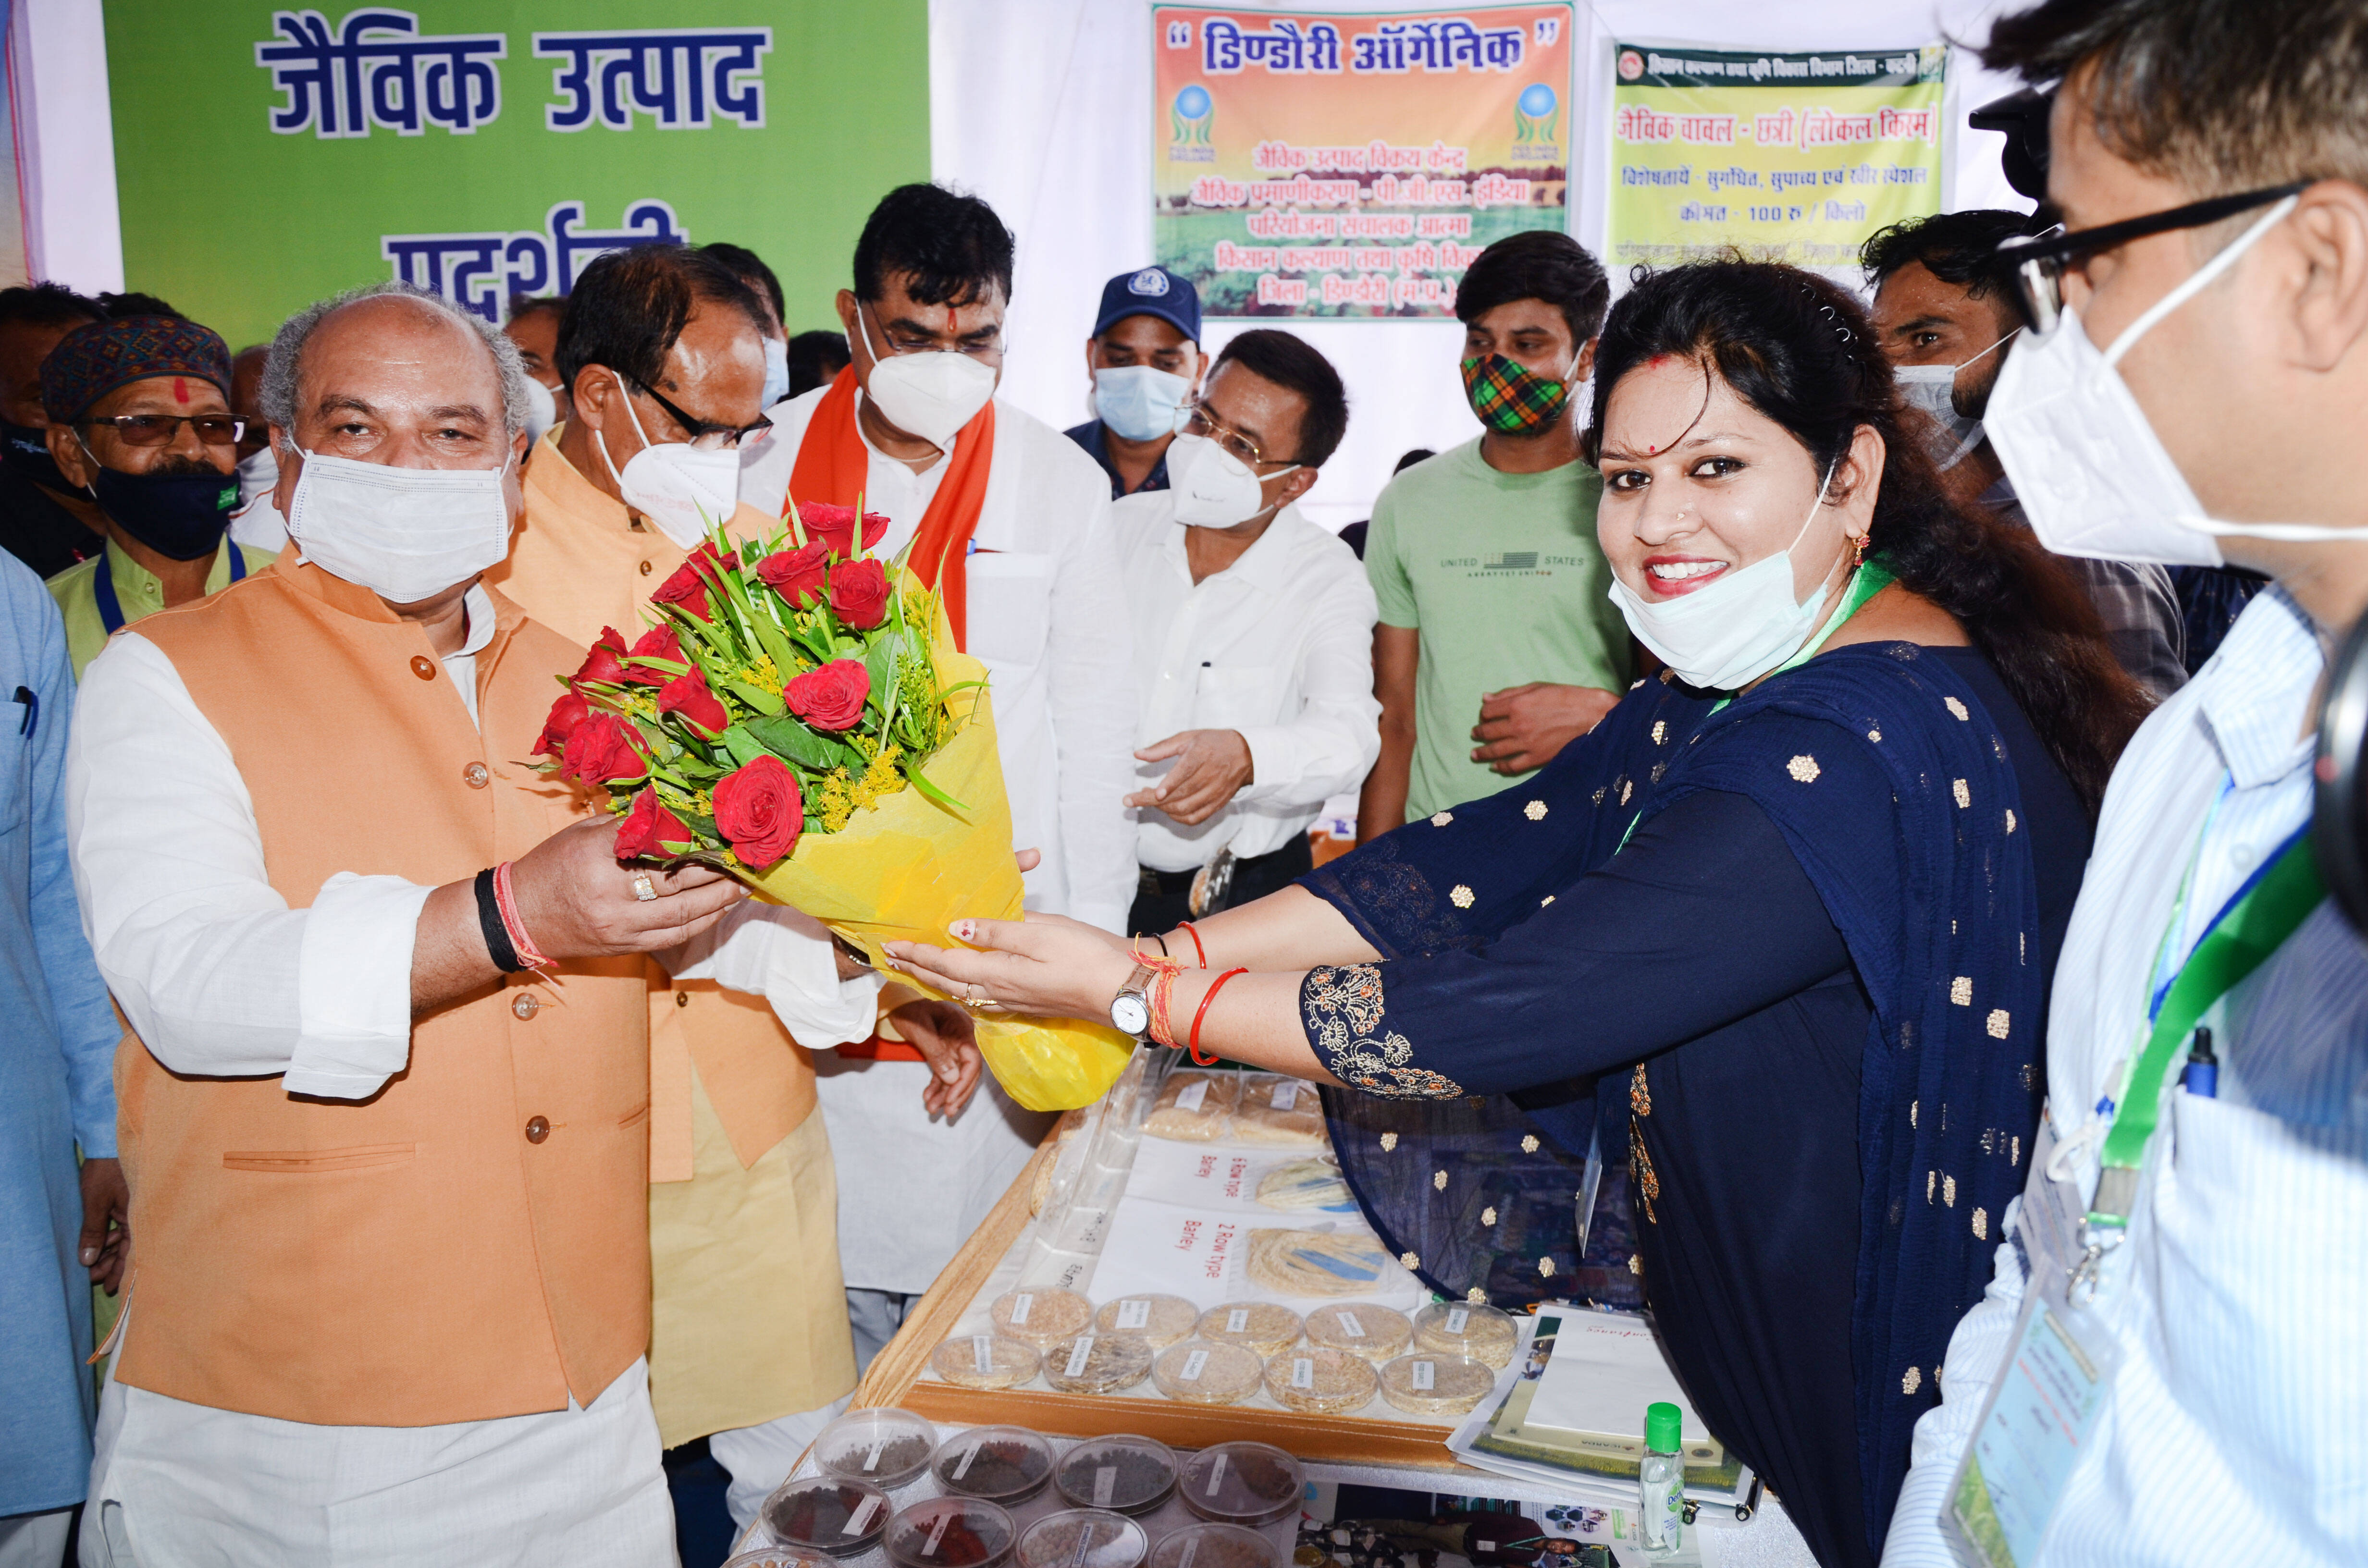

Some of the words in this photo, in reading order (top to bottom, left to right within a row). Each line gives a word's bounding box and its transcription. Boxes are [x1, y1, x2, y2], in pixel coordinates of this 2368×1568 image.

[1205, 22, 1338, 70] डिण्डौरी
[1354, 22, 1522, 70] ऑर्गेनिक
[260, 12, 502, 135] जैविक
[538, 33, 767, 127] उत्पाद
[1618, 107, 1676, 140] जैविक
[1680, 116, 1734, 142] चावल
[1254, 143, 1307, 168] जैविक
[1311, 147, 1364, 169] उत्पाद
[1193, 178, 1246, 202] जैविक
[1249, 209, 1337, 235] परियोजना
[1342, 210, 1412, 235] संचालक
[1418, 215, 1468, 235] आत्मा
[1679, 200, 1727, 221] कीमत
[1749, 207, 1781, 221] 100
[1217, 242, 1277, 268] किसान
[1282, 248, 1351, 268] कल्याण
[1356, 248, 1391, 268] तथा
[1397, 243, 1435, 276] कृषि
[1260, 276, 1306, 303] जिला
[1324, 276, 1387, 302] डिण्डौरी
[1440, 557, 1478, 568] UNITED
[1544, 555, 1585, 566] STATES
[1193, 1155, 1218, 1179] Barley
[1228, 1164, 1246, 1179] Row
[1222, 1180, 1243, 1198] type
[1173, 1219, 1203, 1251] Barley
[1212, 1231, 1234, 1253] Row
[1203, 1255, 1227, 1278] type
[1580, 1440, 1621, 1449] ICARDA
[1668, 1489, 1682, 1506] Dett
